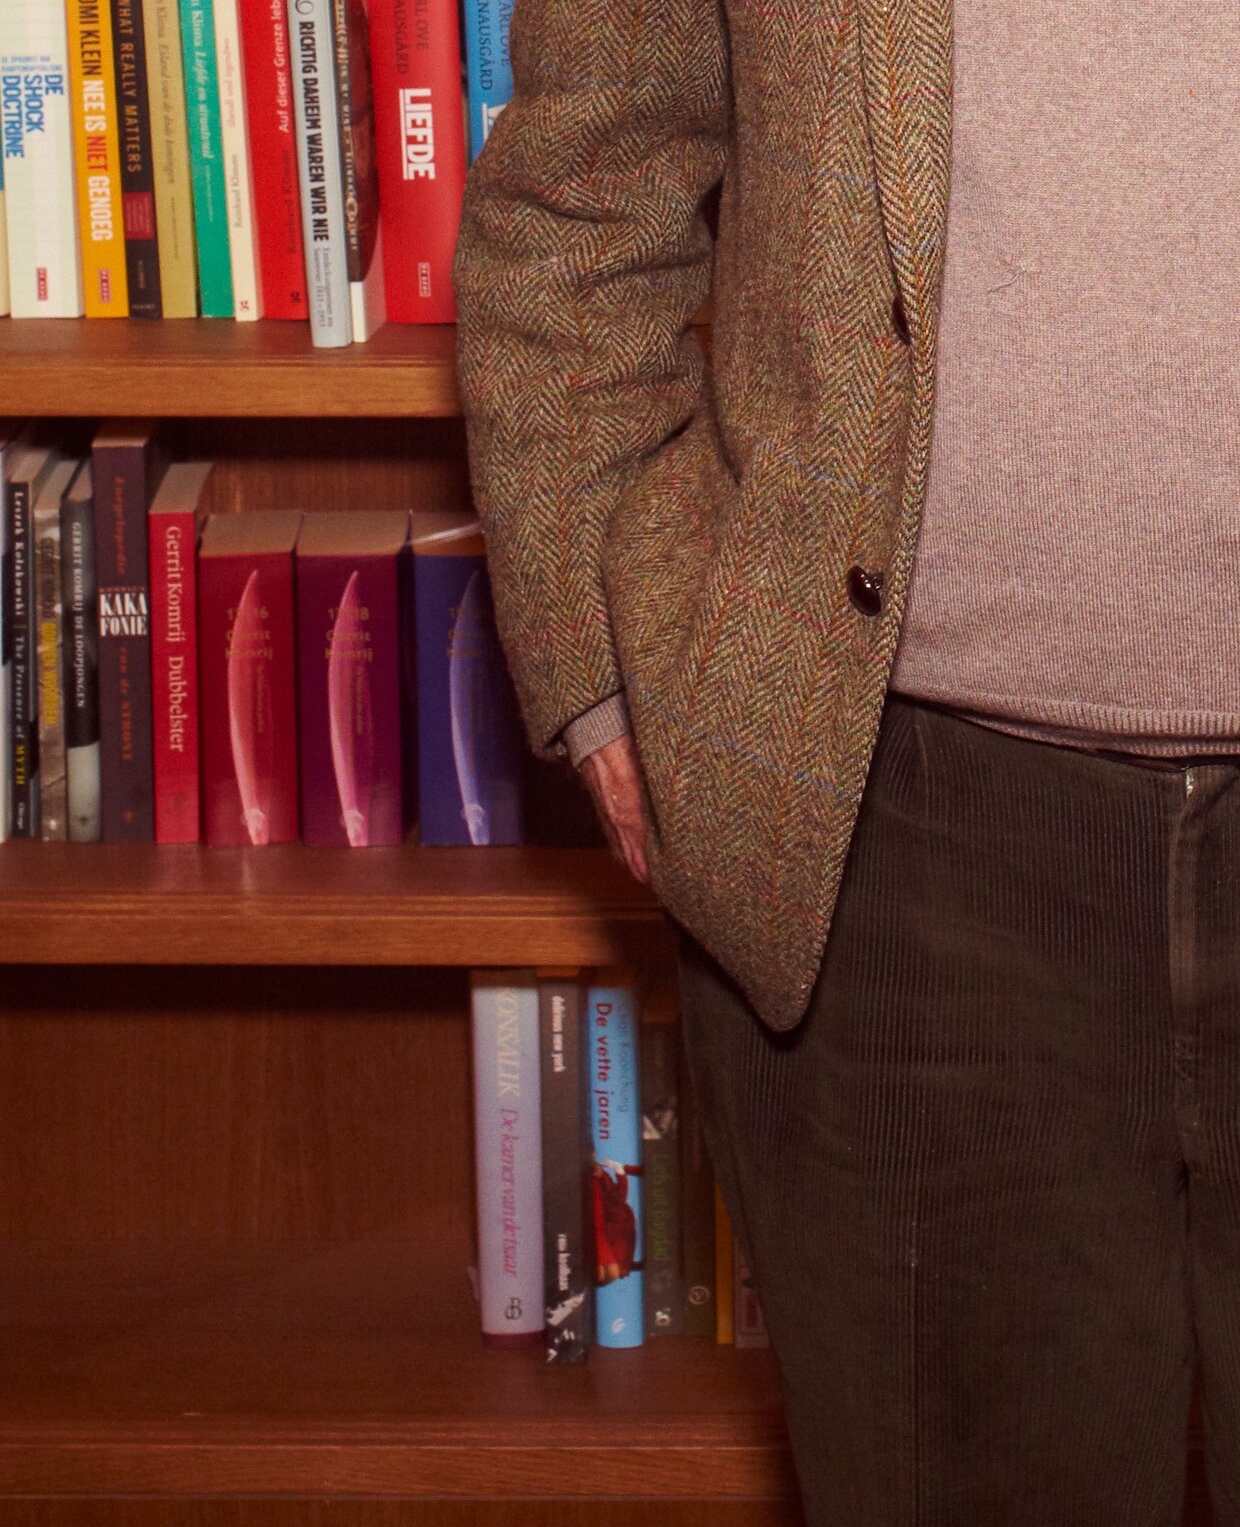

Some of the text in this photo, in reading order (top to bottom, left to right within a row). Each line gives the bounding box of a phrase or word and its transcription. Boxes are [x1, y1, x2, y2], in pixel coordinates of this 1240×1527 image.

[80, 28, 101, 77] KLEIN
[119, 42, 138, 97] REALLY
[2, 74, 24, 159] DOCTRINE
[24, 74, 45, 134] SHOCK
[44, 74, 64, 97] DE
[85, 79, 109, 112] NEE
[86, 115, 110, 132] IS
[88, 134, 110, 171] NIET
[122, 104, 141, 173] MATTERS
[298, 20, 330, 242] RICHTIG DAHEIM WAREN WIR NIE
[404, 88, 436, 180] LIEFDE
[88, 175, 114, 241] GENOEG
[164, 526, 187, 753] Gerrit Komrij Dubbelster
[593, 1002, 614, 1141] De vette jaren
